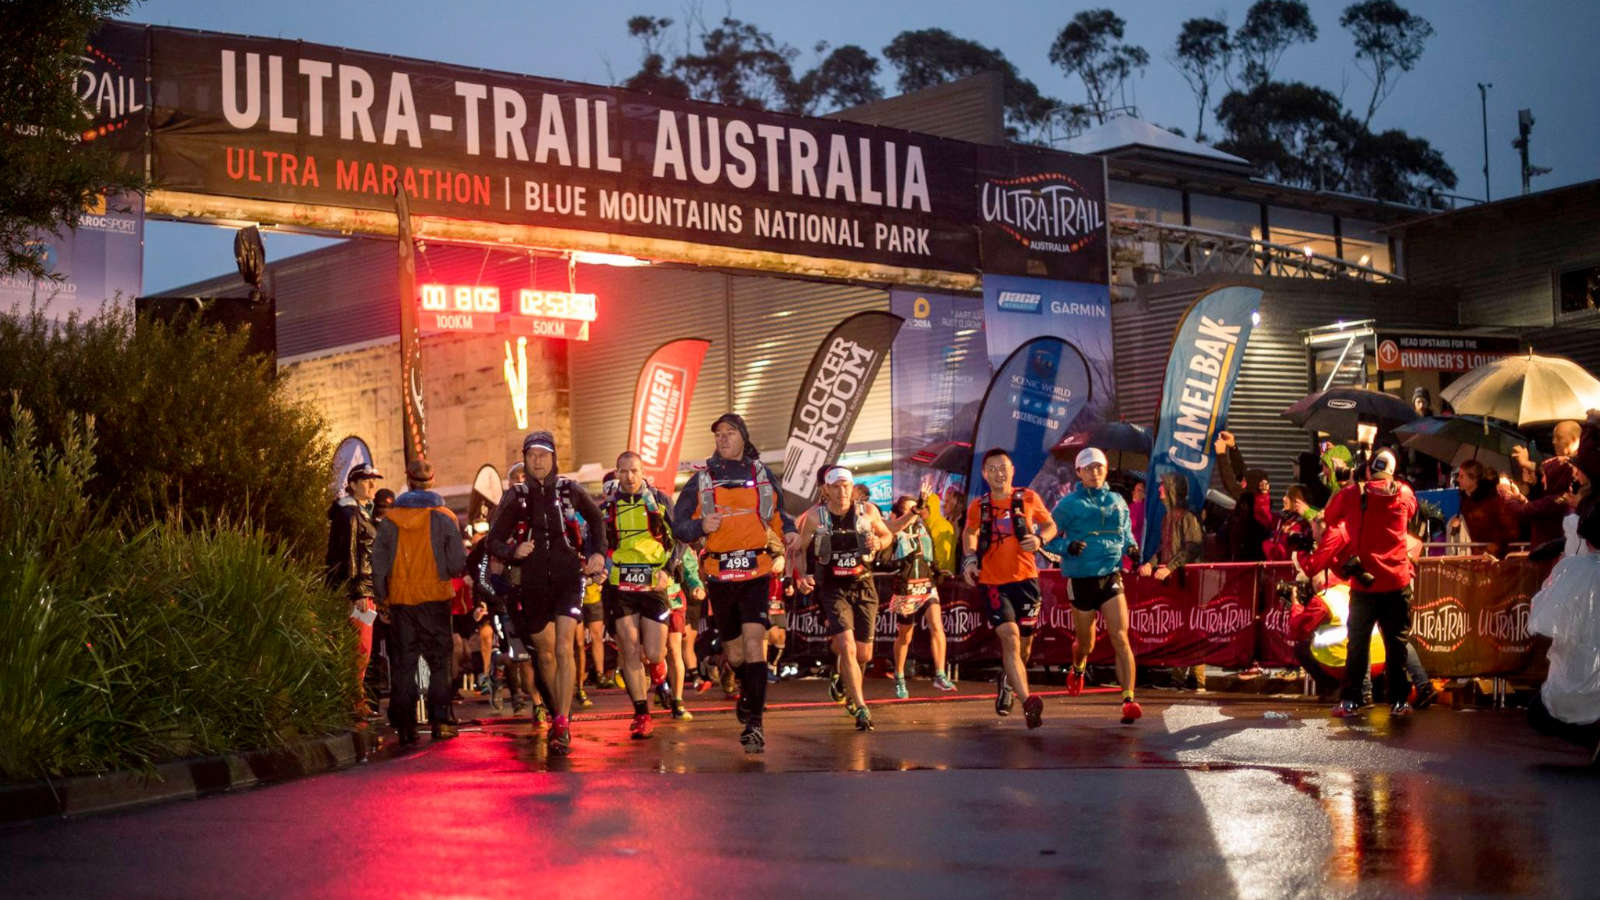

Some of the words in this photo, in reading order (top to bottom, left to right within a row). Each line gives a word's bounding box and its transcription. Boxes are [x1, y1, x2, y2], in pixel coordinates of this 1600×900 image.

[221, 49, 622, 172] ULTRA-TRAIL
[653, 109, 932, 213] AUSTRALIA
[226, 147, 320, 187] ULTRA
[336, 159, 491, 205] MARATHON
[525, 181, 587, 217] BLUE
[600, 189, 743, 234] MOUNTAINS
[754, 207, 865, 248] NATIONAL
[875, 222, 931, 256] PARK
[982, 182, 1104, 237] ULTRA-TRAIL
[1030, 241, 1071, 253] AUSTRALIA
[1050, 301, 1106, 318] GARMIN
[436, 314, 473, 329] 100KM
[533, 320, 565, 336] 50KM
[1451, 338, 1464, 348] FOR
[1401, 351, 1464, 369] RUNNER'S
[792, 336, 853, 442] LOCKER
[812, 340, 874, 450] ROOM
[1168, 315, 1242, 472] CAMELBAK
[640, 368, 674, 466] HAMMER
[726, 557, 750, 569] 498
[837, 557, 857, 568] 448
[625, 572, 646, 583] 440
